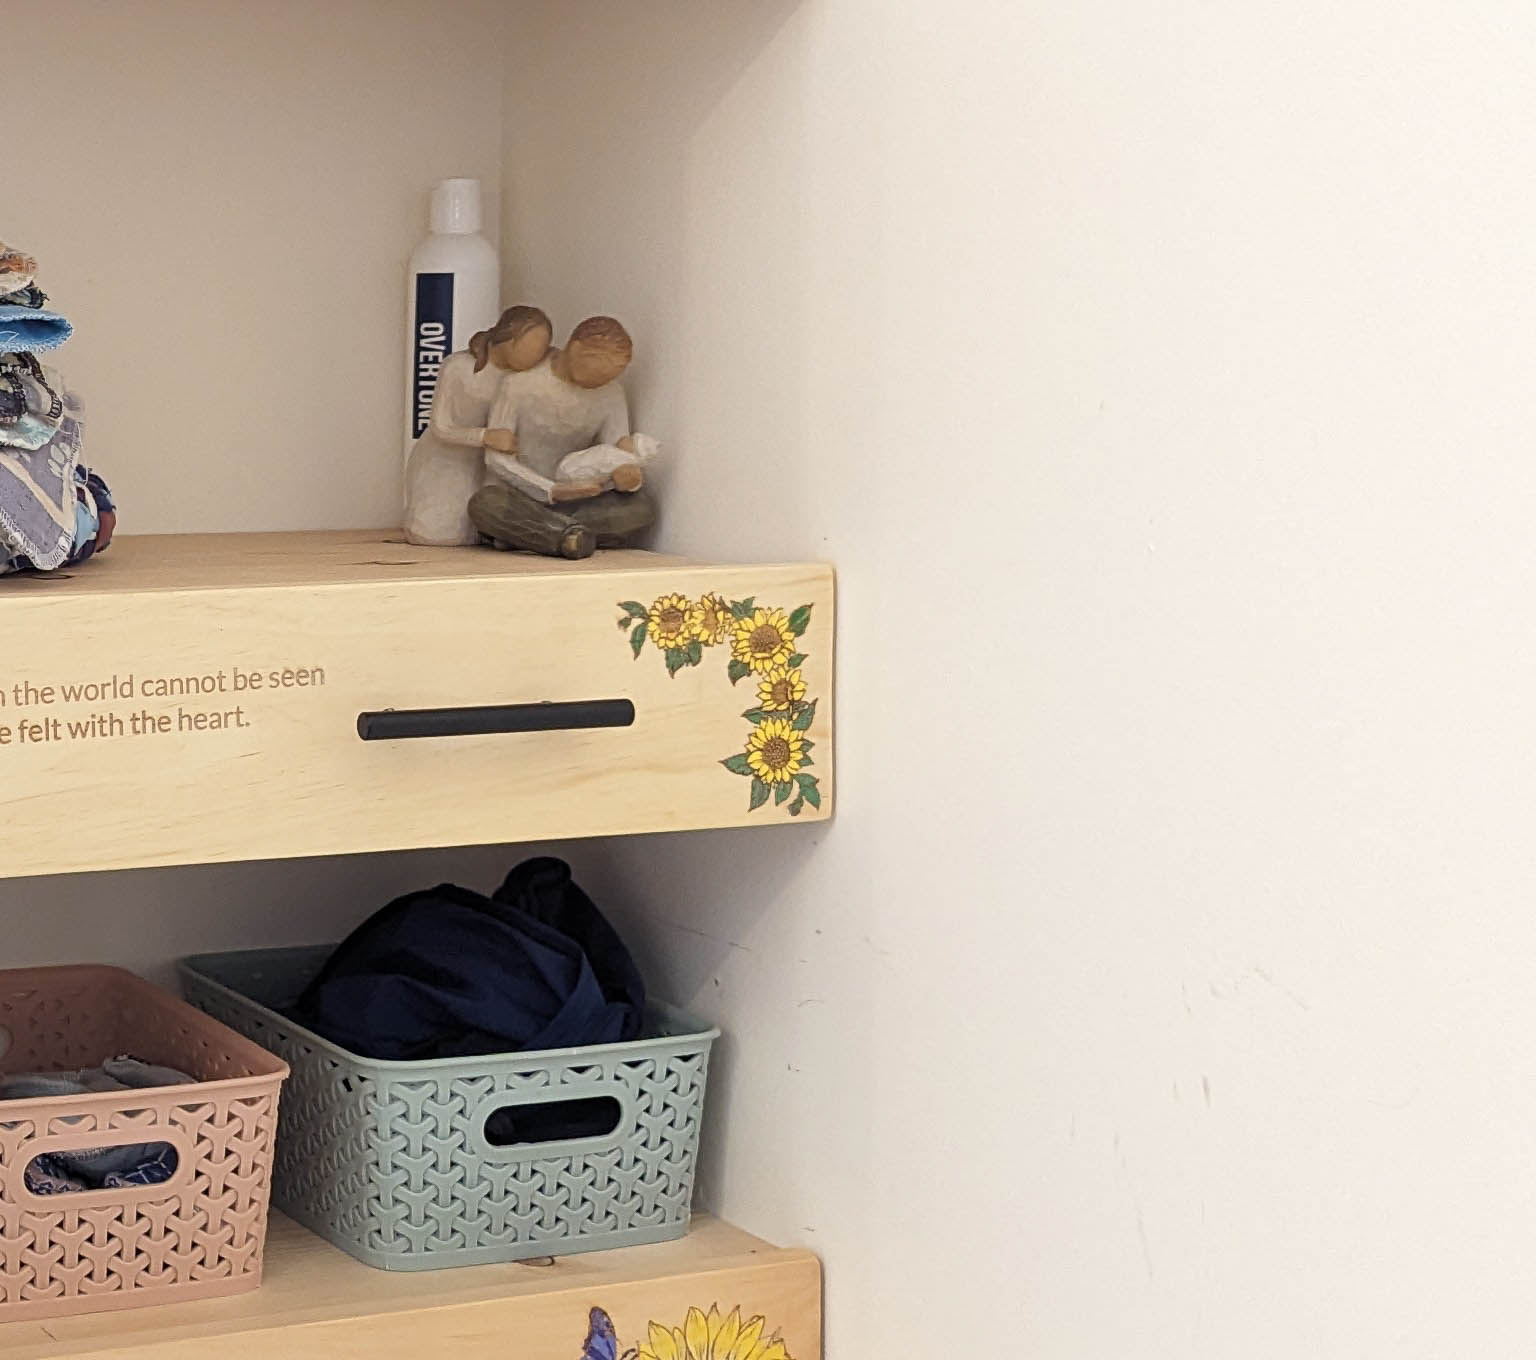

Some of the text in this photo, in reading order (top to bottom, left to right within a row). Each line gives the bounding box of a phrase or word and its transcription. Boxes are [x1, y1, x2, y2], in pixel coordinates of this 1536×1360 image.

[12, 680, 56, 706] the
[61, 673, 134, 702] world
[140, 670, 227, 697] cannot
[232, 666, 263, 691] be
[268, 666, 326, 690] seen
[17, 717, 62, 744] felt
[66, 712, 125, 739] with
[130, 709, 172, 735] the
[177, 705, 251, 732] heart.
